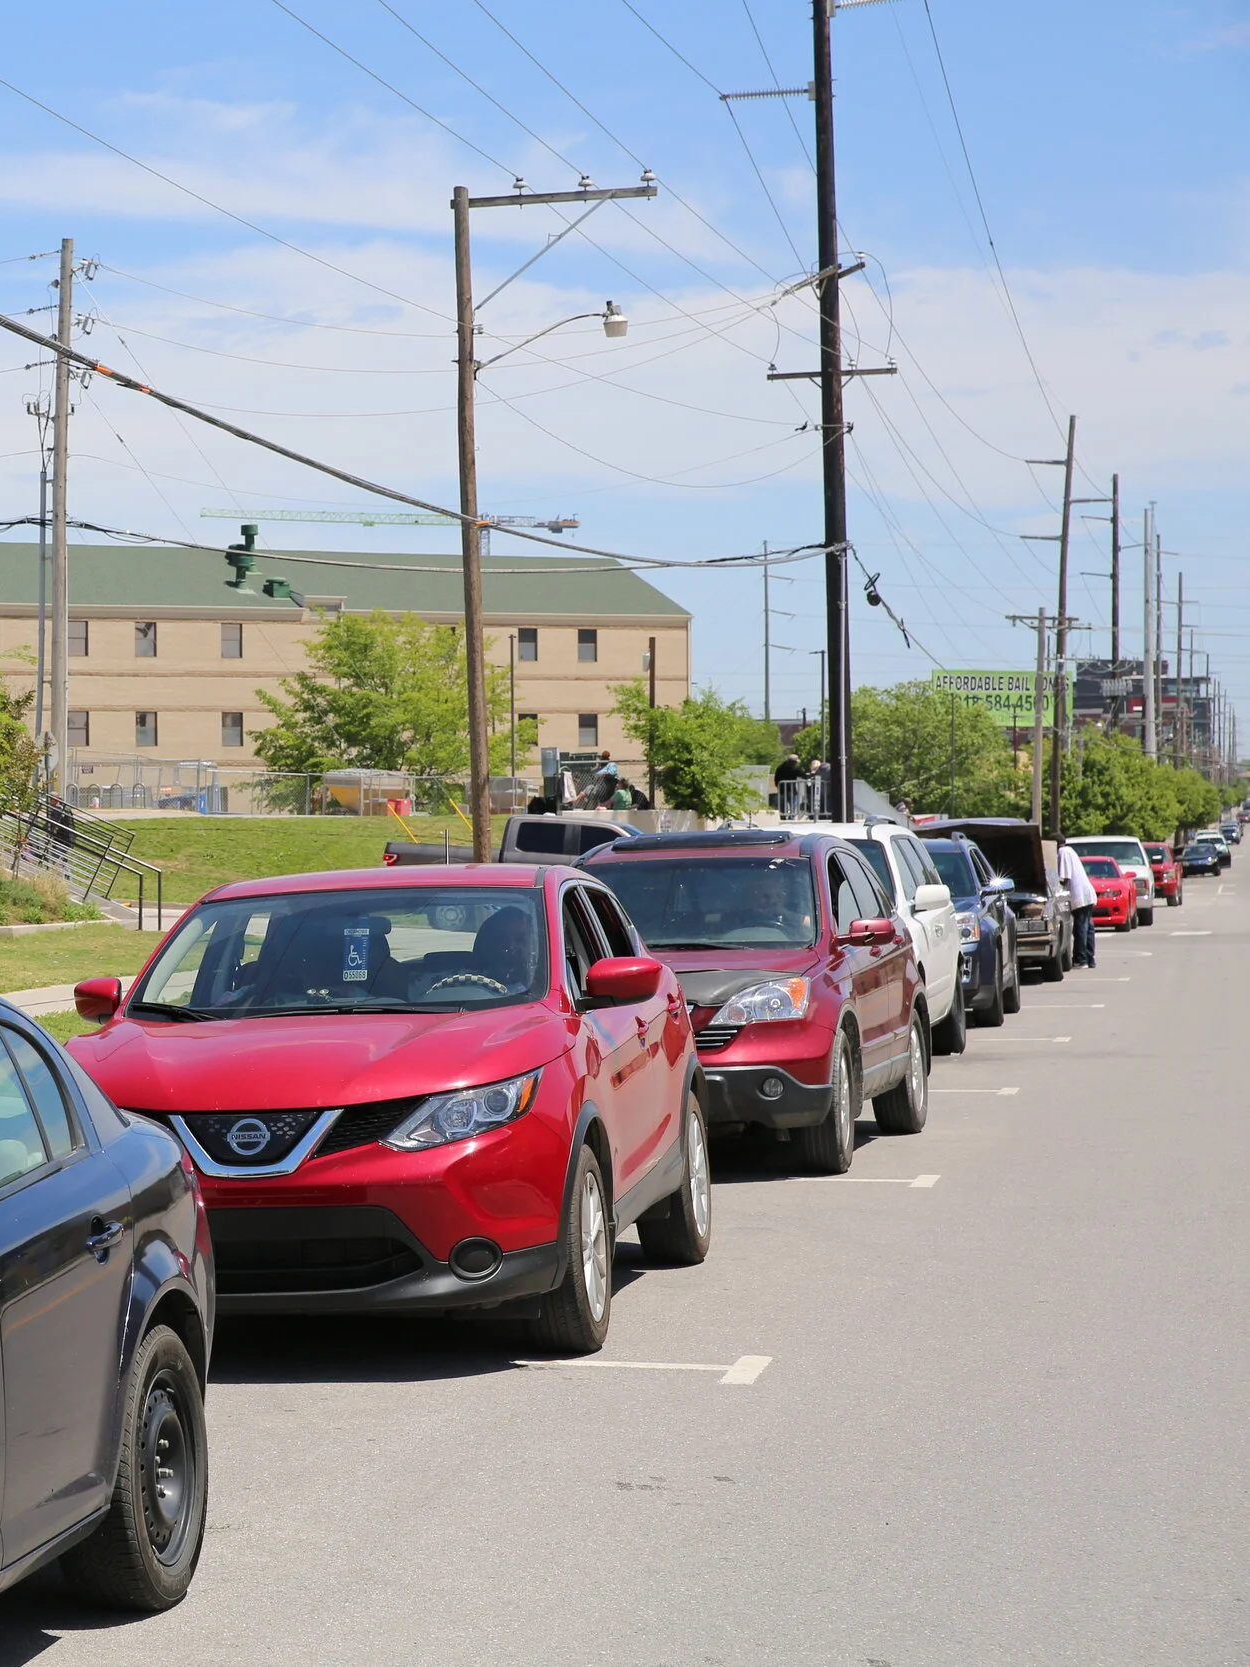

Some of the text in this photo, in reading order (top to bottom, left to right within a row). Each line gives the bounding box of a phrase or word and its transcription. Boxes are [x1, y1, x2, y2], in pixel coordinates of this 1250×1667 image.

[936, 675, 1004, 691] AFFORDABLE
[1008, 676, 1030, 691] BAIL
[231, 1133, 266, 1141] NISSAN
